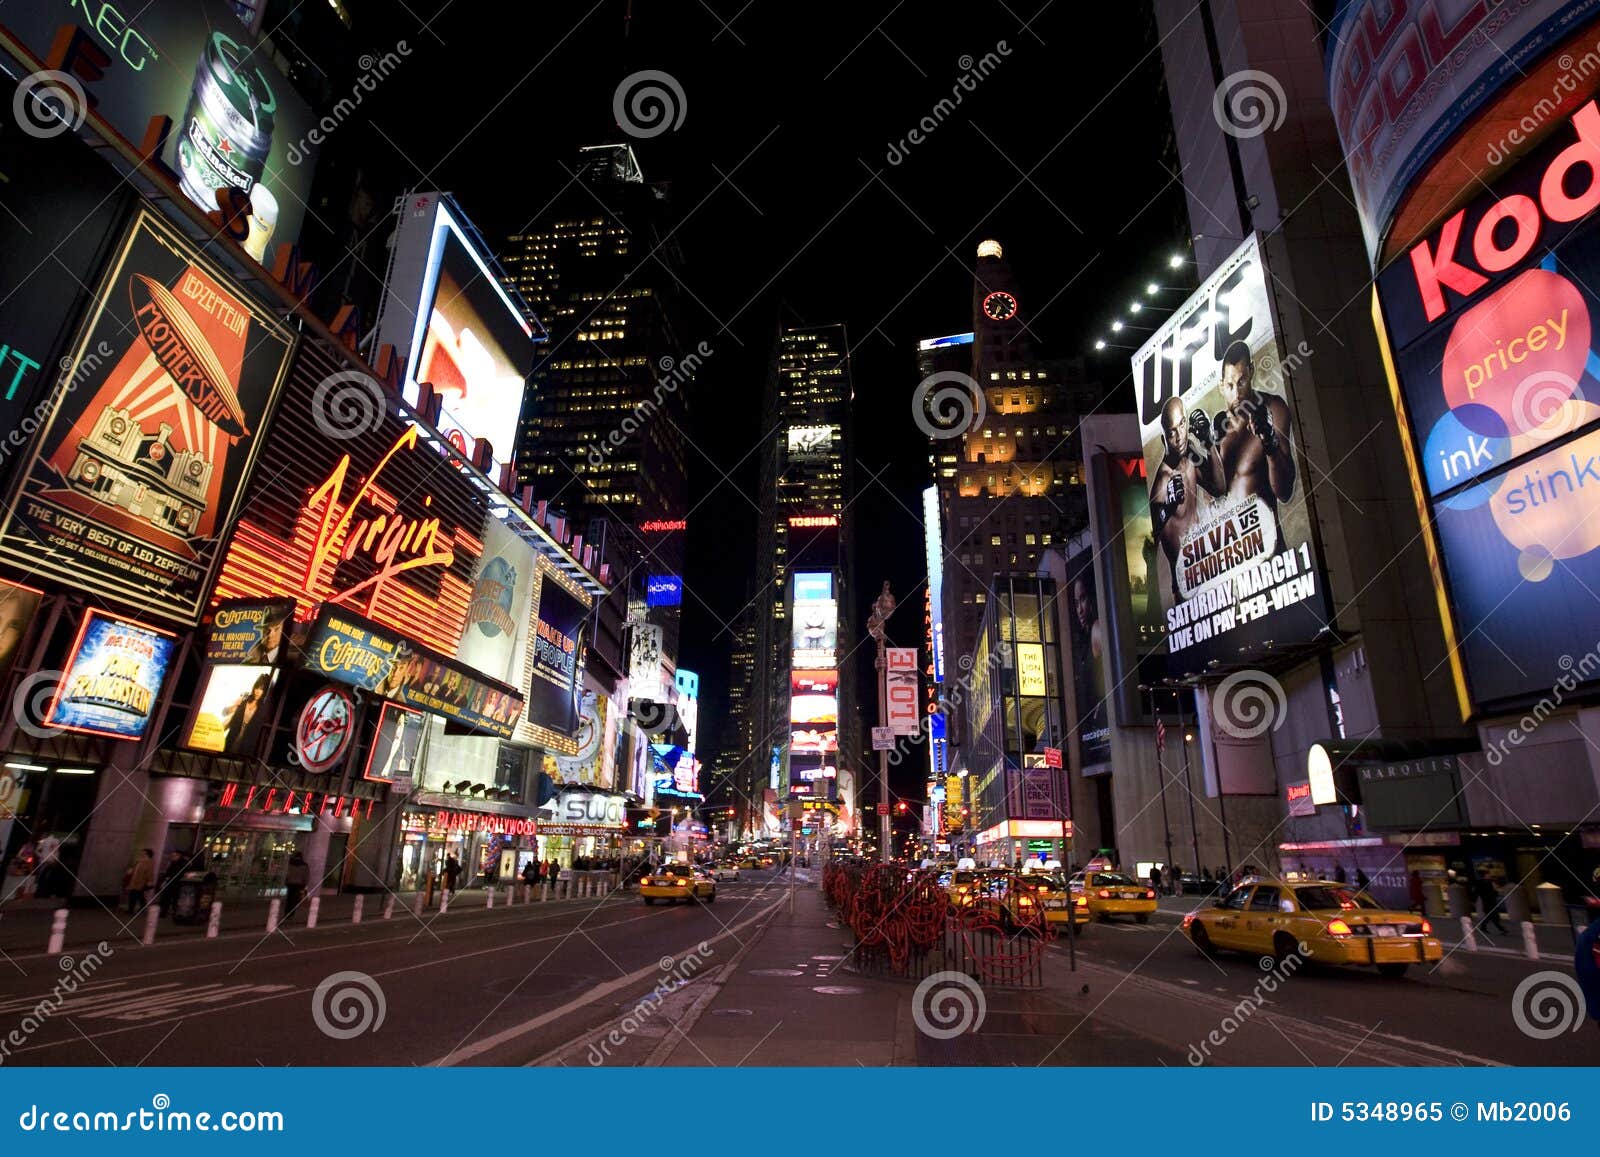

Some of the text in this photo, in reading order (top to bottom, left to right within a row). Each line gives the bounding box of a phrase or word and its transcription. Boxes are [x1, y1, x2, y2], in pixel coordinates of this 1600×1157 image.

[191, 123, 251, 191] Heineken
[198, 283, 250, 338] ZEPPELIN
[137, 302, 232, 422] MOTHERSHIP
[1143, 260, 1253, 425] UFC
[1463, 309, 1569, 399] pricey
[1440, 435, 1493, 480] ink
[1506, 453, 1600, 515] stink
[28, 502, 199, 581] THE VERY BEST OF LED ZEPPELIN
[305, 424, 454, 619] Virgin
[788, 516, 838, 527] TOSHIBA
[1182, 509, 1260, 568] SILVA VS
[1192, 524, 1210, 539] CHAMP
[1236, 494, 1257, 514] CHAMP
[1166, 541, 1312, 631] SATURDAY, MARCH 1
[1184, 528, 1265, 592] HENDERSON
[1168, 571, 1316, 654] LIVE ON PAY-PER-VIEW
[535, 636, 574, 674] PEOPLE
[1361, 758, 1452, 781] MARQUIS
[438, 811, 536, 836] PLANET HOLLYWOOD
